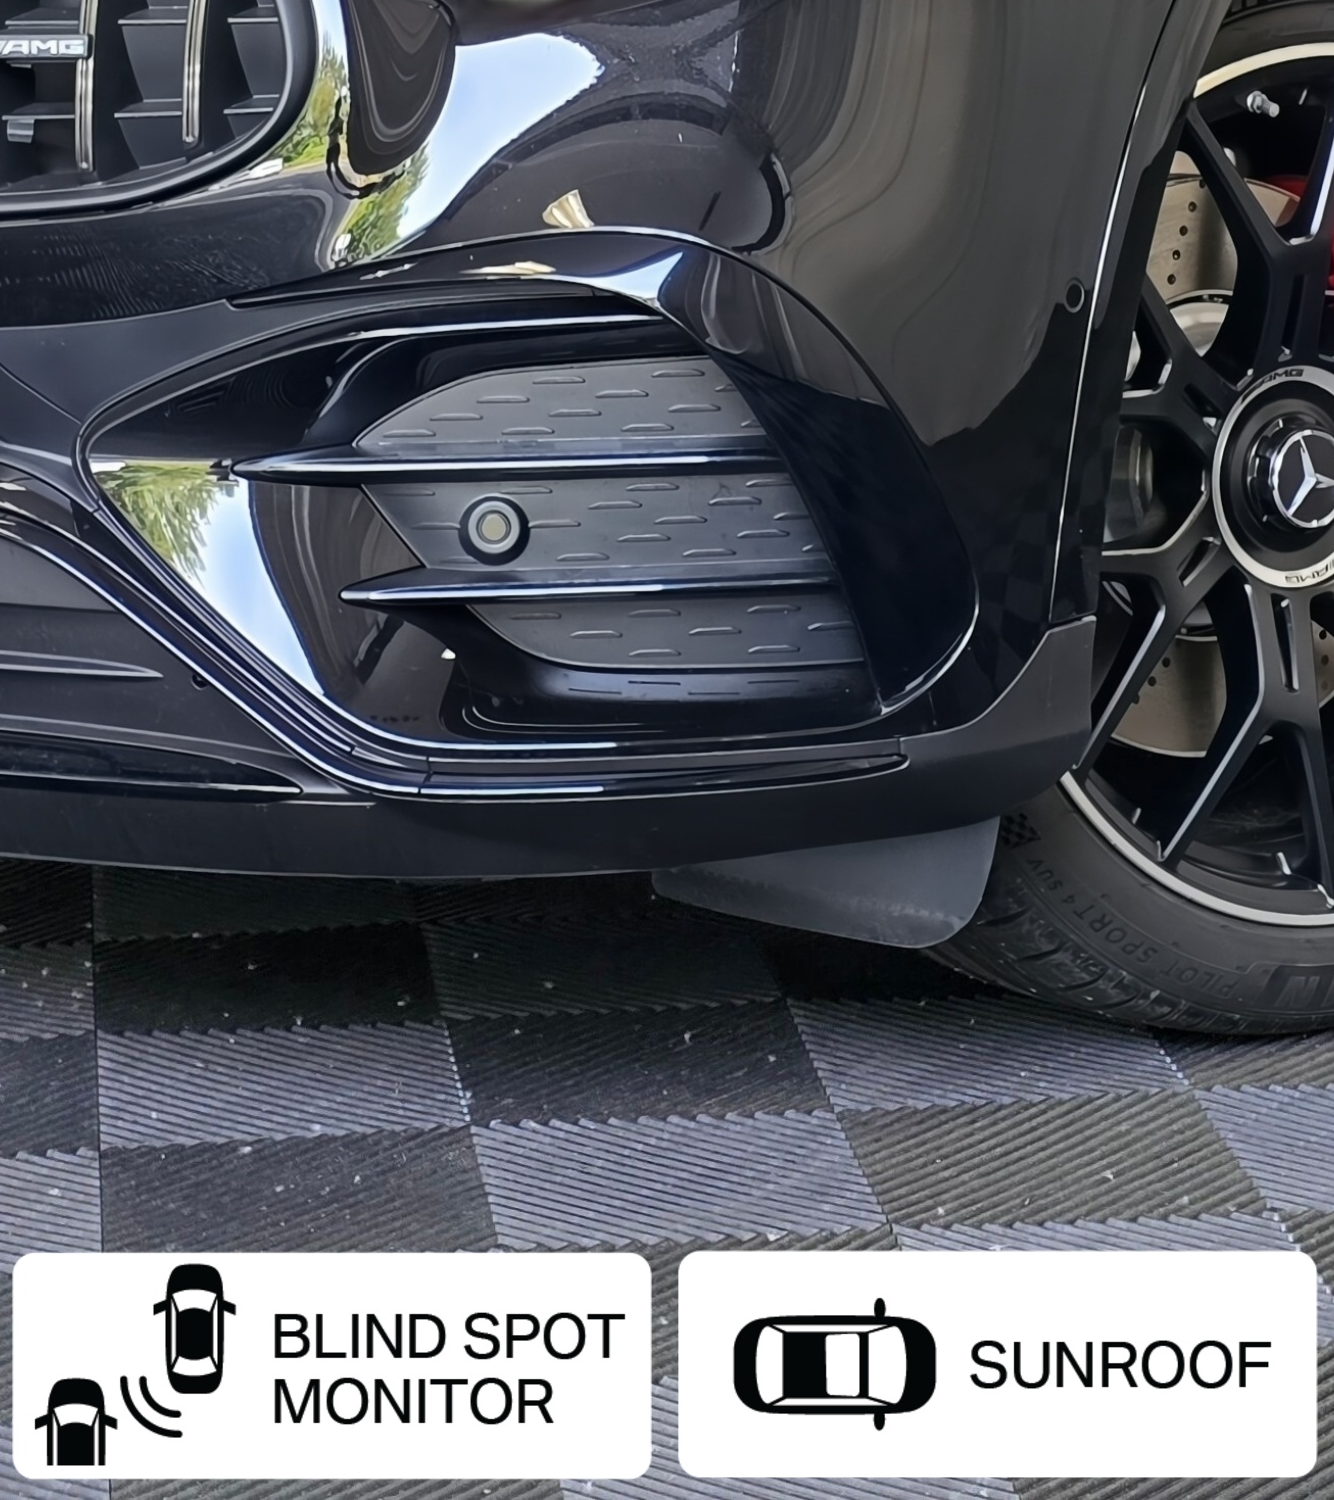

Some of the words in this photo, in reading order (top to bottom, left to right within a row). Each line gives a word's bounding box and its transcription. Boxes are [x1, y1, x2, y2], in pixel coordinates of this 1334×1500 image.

[2, 39, 85, 55] AMG
[1026, 856, 1064, 892] SUV
[1073, 903, 1158, 964] SPORT
[1165, 959, 1239, 999] PILOT
